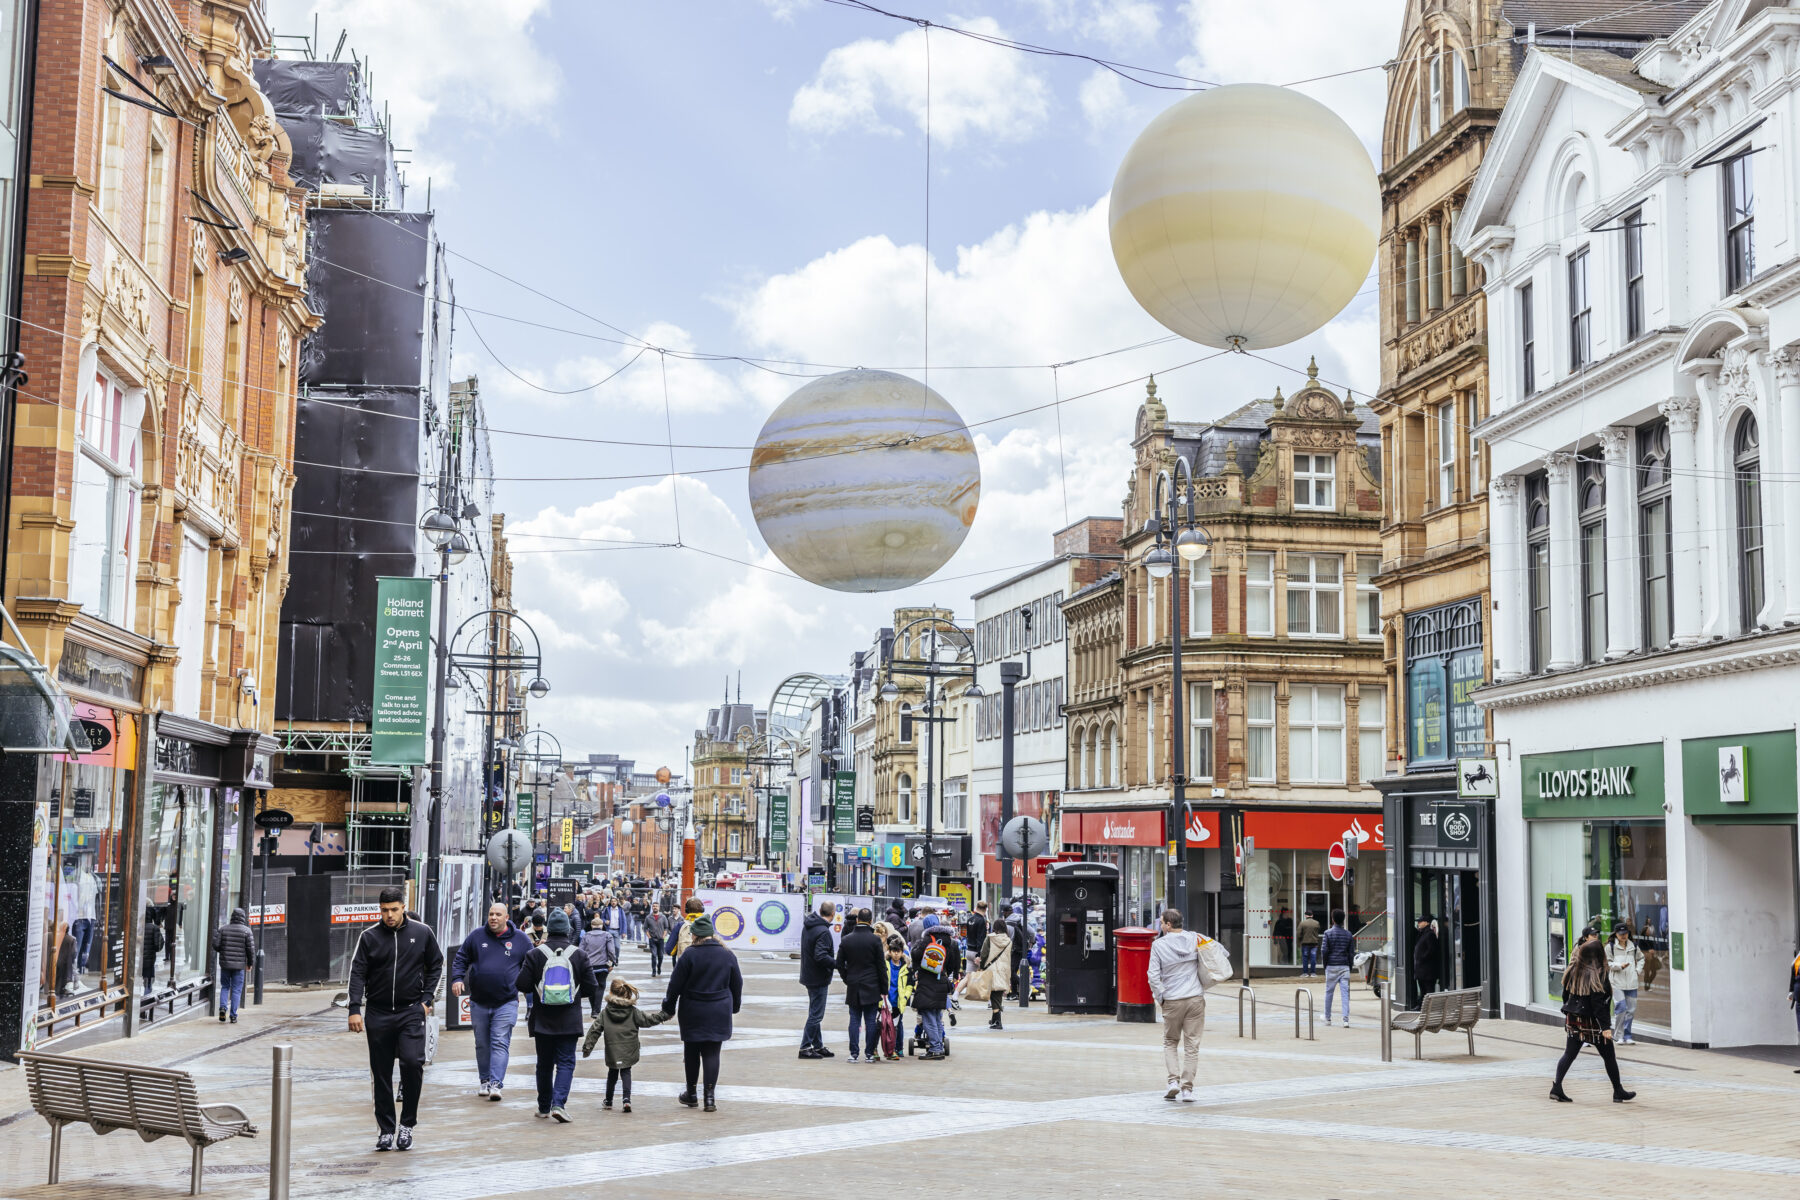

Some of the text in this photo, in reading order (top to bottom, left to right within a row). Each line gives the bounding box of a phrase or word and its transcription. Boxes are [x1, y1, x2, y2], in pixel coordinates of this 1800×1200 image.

[387, 598, 424, 608] Holland
[387, 627, 420, 638] Opens
[398, 640, 423, 651] April
[1453, 656, 1465, 680] FILL
[1466, 655, 1475, 677] ME
[1454, 681, 1466, 704] FILL
[1454, 706, 1466, 729] FILL
[1467, 704, 1475, 726] ME
[1454, 730, 1466, 753] FILL
[1467, 730, 1476, 752] ME
[1539, 766, 1634, 798] LLOYDS BANK
[1110, 819, 1136, 838] Santander
[1420, 813, 1436, 826] THE B
[1374, 824, 1384, 843] S
